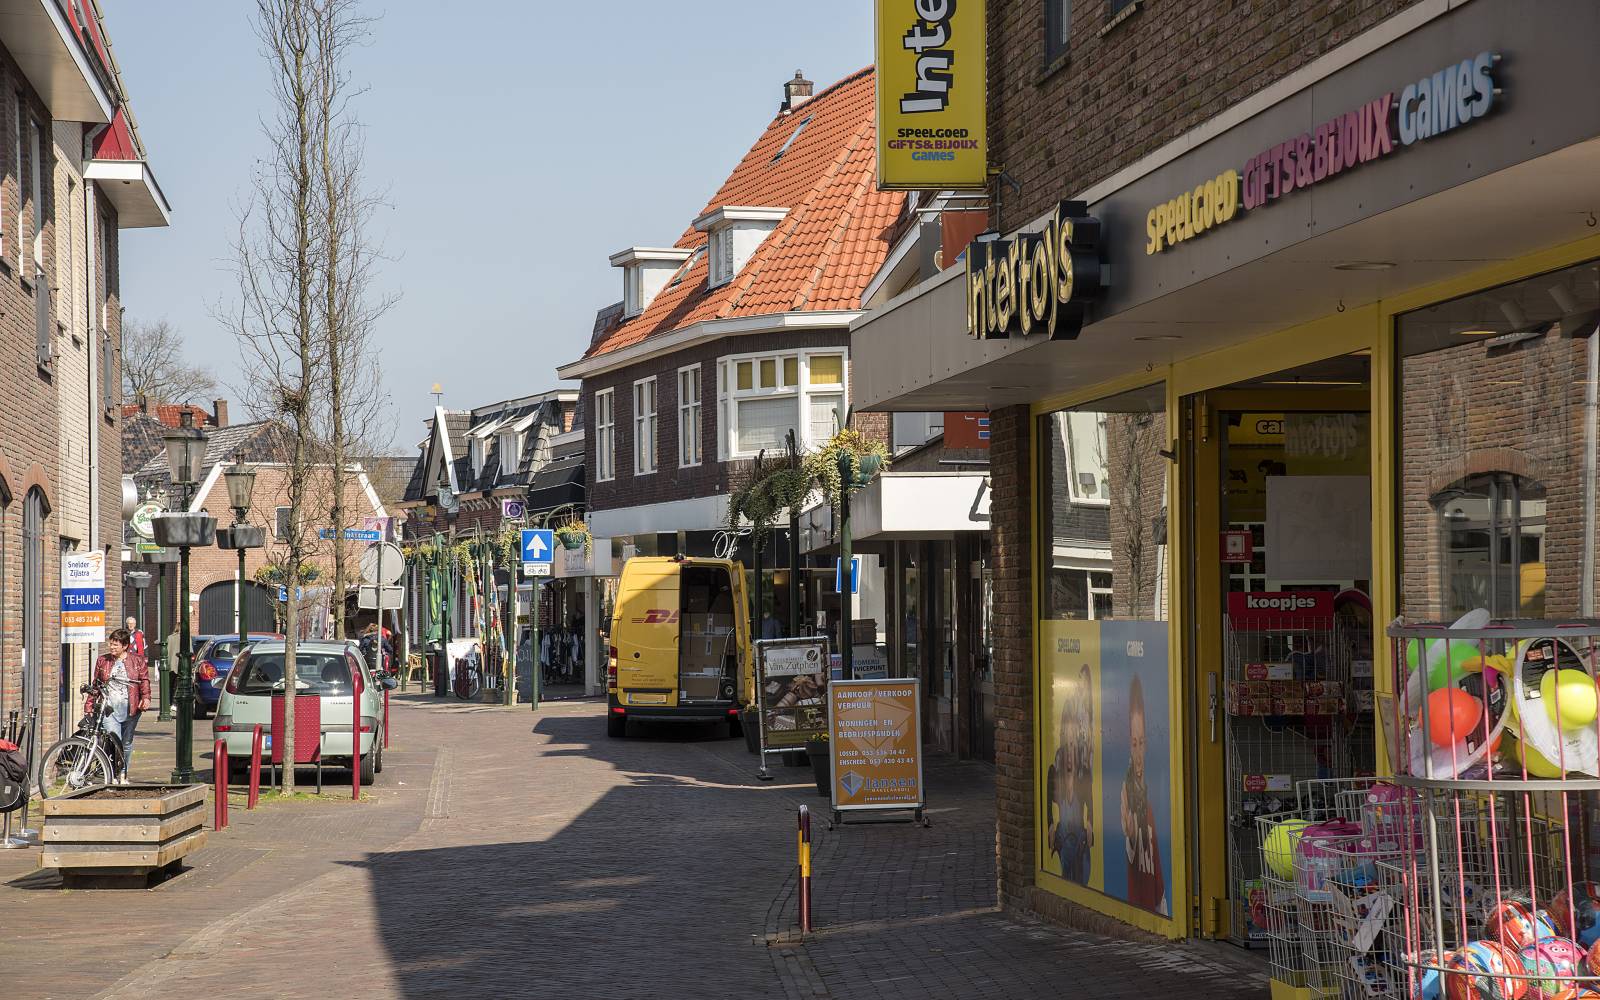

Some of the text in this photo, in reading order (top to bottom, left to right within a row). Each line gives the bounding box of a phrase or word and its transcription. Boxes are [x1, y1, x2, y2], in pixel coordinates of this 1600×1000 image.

[67, 561, 90, 569] Snelder
[64, 594, 100, 605] TE HUUR
[1247, 595, 1316, 611] koopjes
[768, 663, 783, 671] Van
[786, 660, 819, 672] Zutphen
[838, 719, 879, 727] WONINGEN
